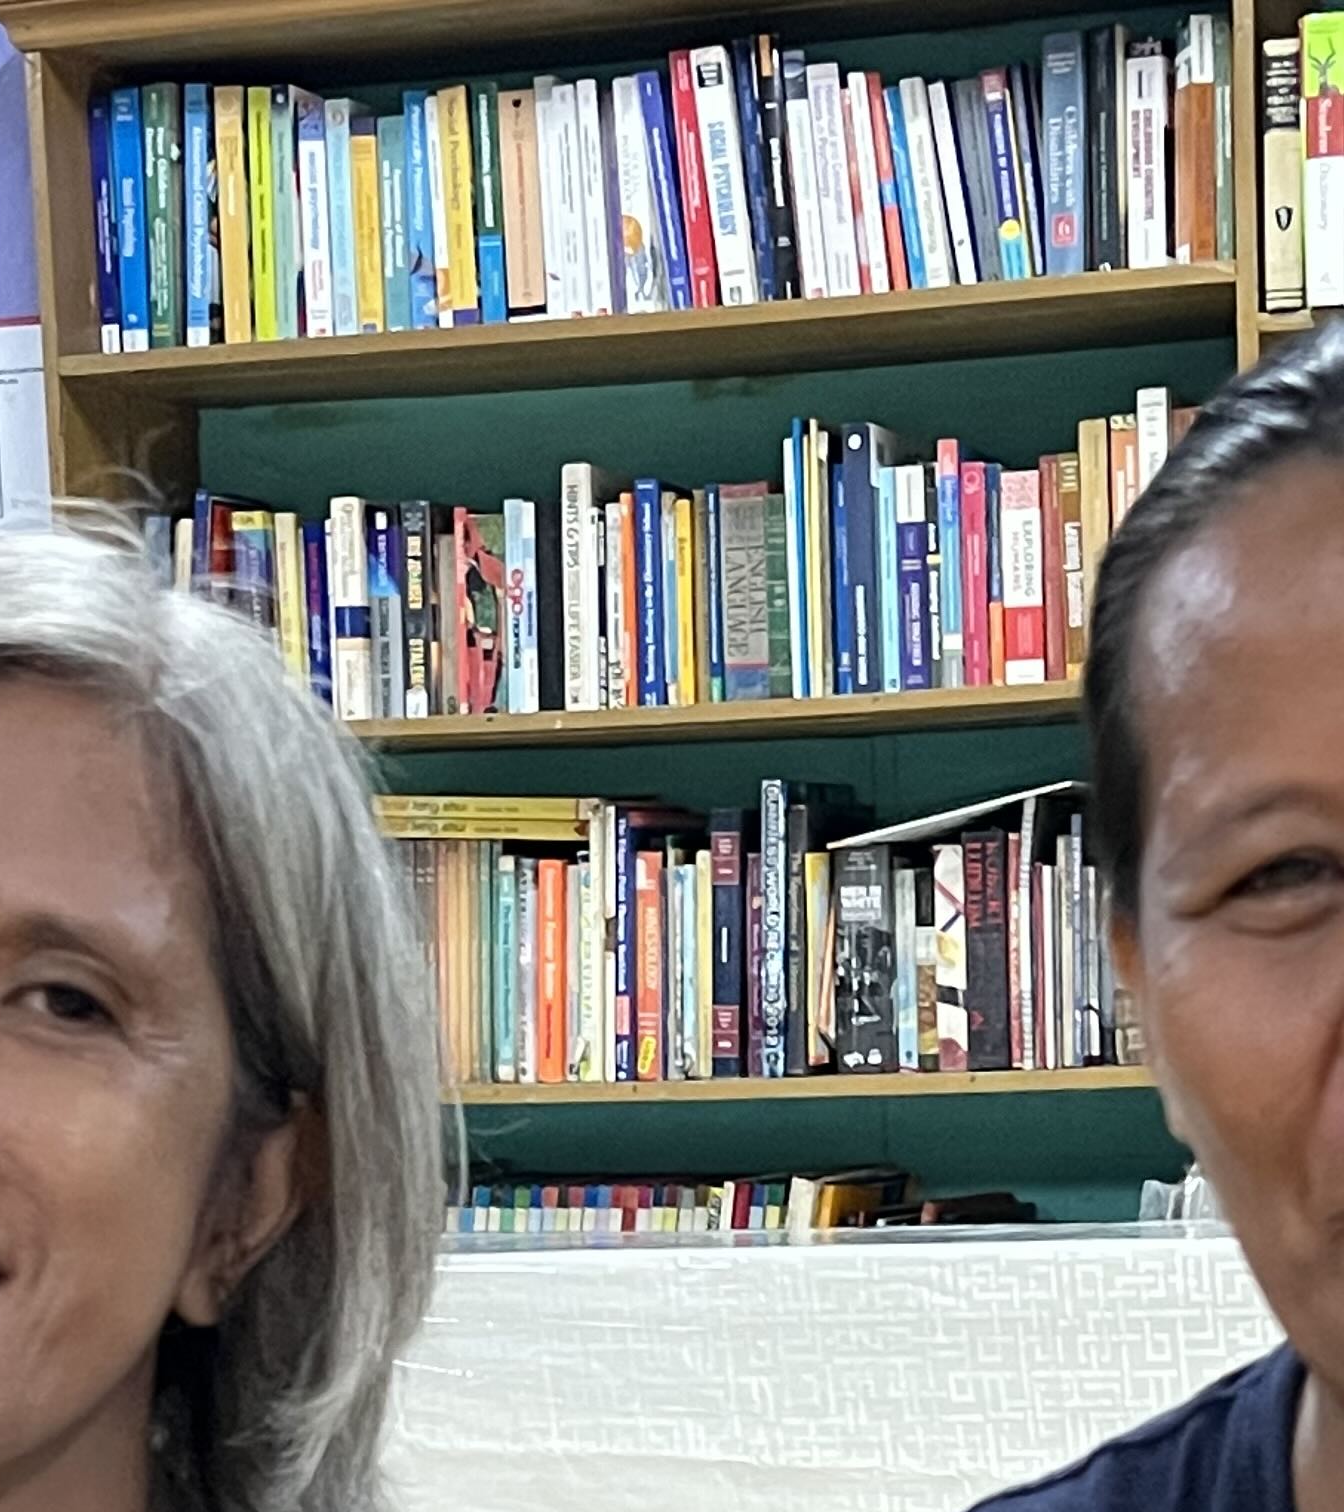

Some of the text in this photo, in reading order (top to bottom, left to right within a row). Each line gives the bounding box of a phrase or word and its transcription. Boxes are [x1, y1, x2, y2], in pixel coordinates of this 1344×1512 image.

[707, 121, 738, 236] SOCIAL PSYCHOLOGY
[1048, 116, 1064, 204] Disabilities
[1064, 105, 1080, 175] Children
[189, 126, 205, 298] Abnormal Child Psychology
[566, 483, 580, 525] HINTS
[567, 543, 581, 569] TIPS
[747, 545, 768, 633] ENGLISH
[1022, 520, 1036, 598] EXPLORING
[568, 604, 582, 631] LIFE
[726, 547, 750, 658] LANGUAGE
[763, 784, 782, 1047] GUINNESS WORLD RECORDS 2012
[968, 841, 985, 929] LUDLUM
[984, 841, 1002, 925] ROBERT
[644, 906, 659, 991] KINESIOLOGY
